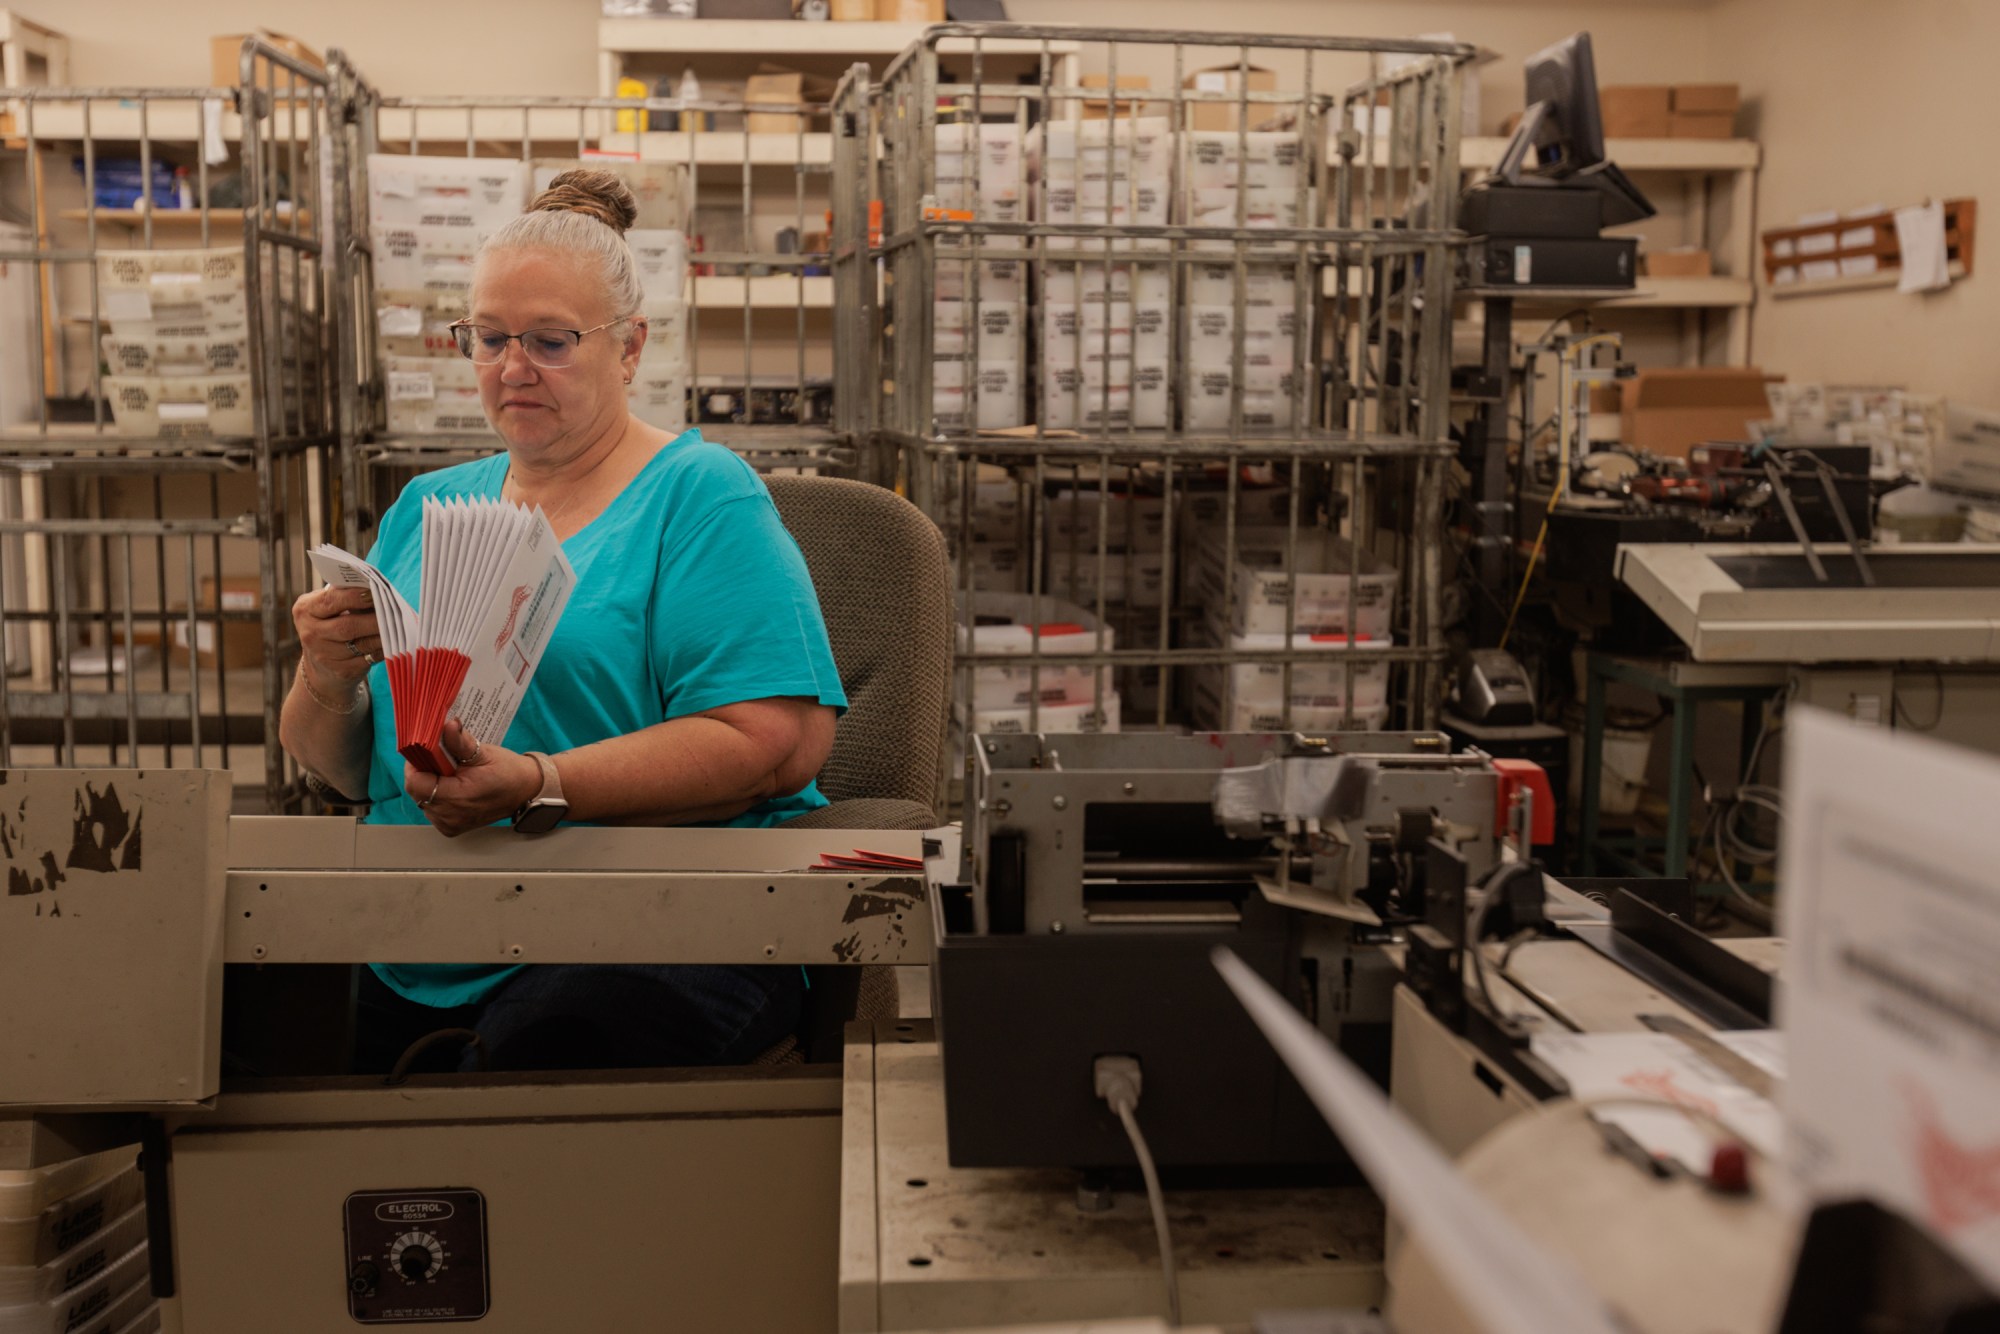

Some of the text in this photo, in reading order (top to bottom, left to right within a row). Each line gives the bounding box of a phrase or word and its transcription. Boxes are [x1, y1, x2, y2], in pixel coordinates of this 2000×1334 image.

[385, 229, 416, 238] LABEL
[385, 238, 418, 248] OTHER
[388, 1203, 442, 1214] ELECTROL
